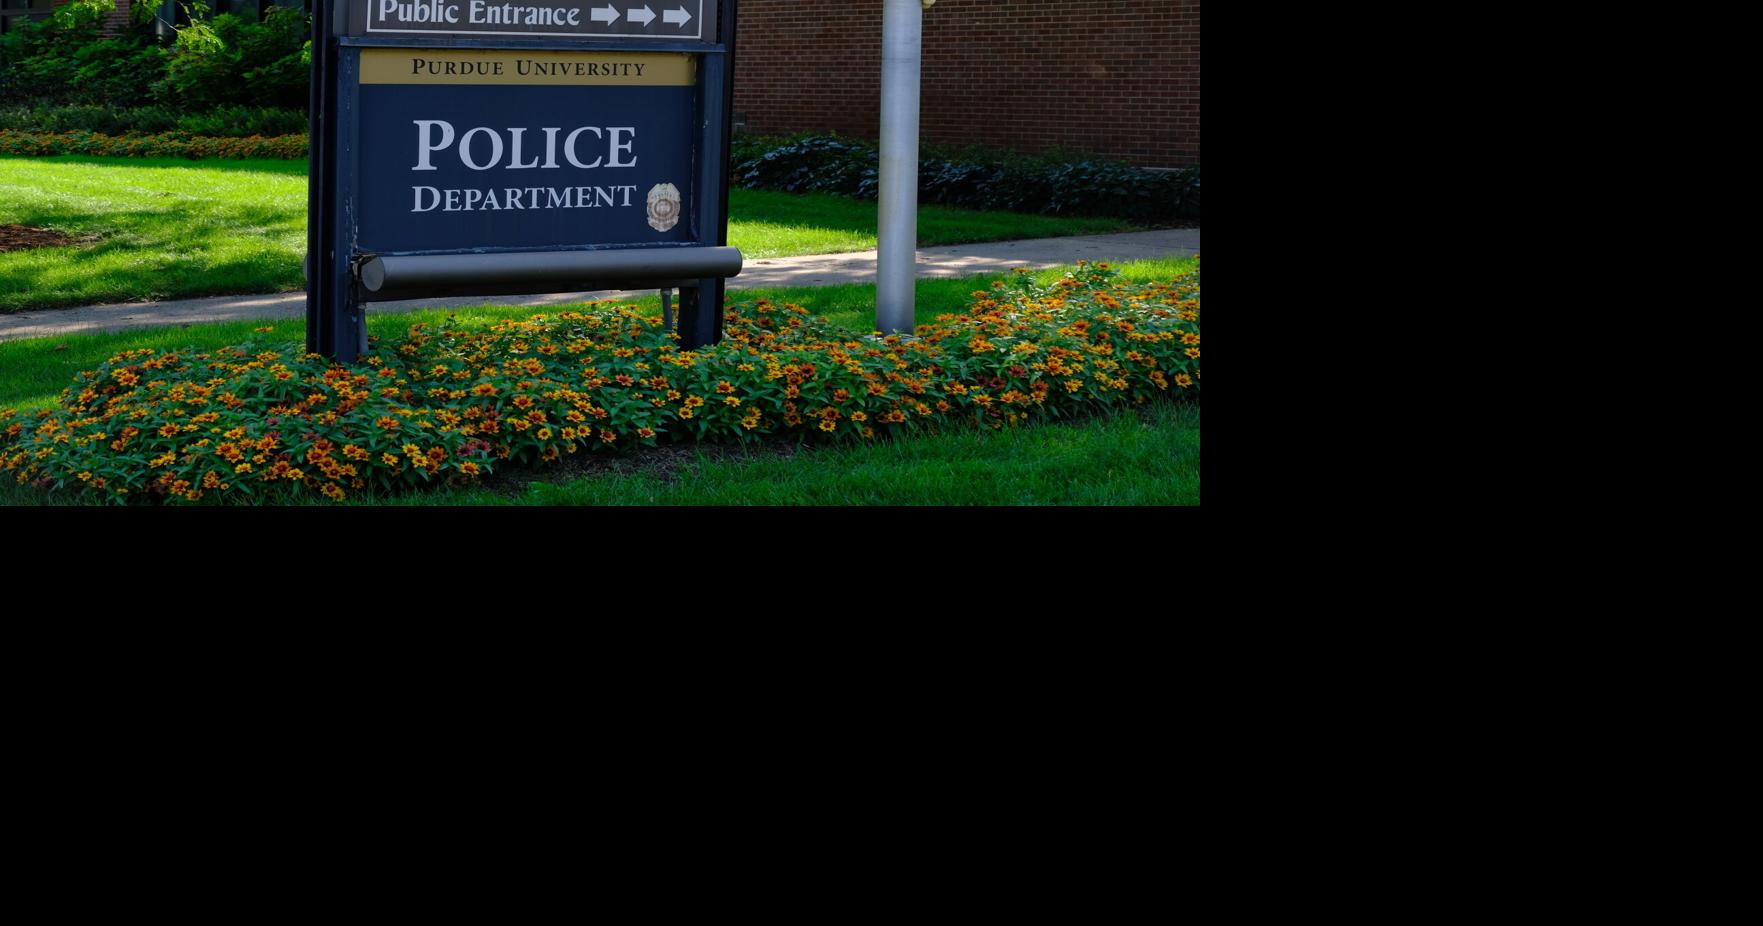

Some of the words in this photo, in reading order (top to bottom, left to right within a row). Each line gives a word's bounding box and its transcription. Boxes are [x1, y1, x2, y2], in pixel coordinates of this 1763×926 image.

[378, 0, 459, 23] Public
[469, 0, 580, 26] Entrance
[412, 58, 504, 76] PURDUE
[516, 59, 645, 77] UNIVERSITY
[411, 119, 637, 171] POLICE
[411, 185, 637, 212] DEPARTMENT
